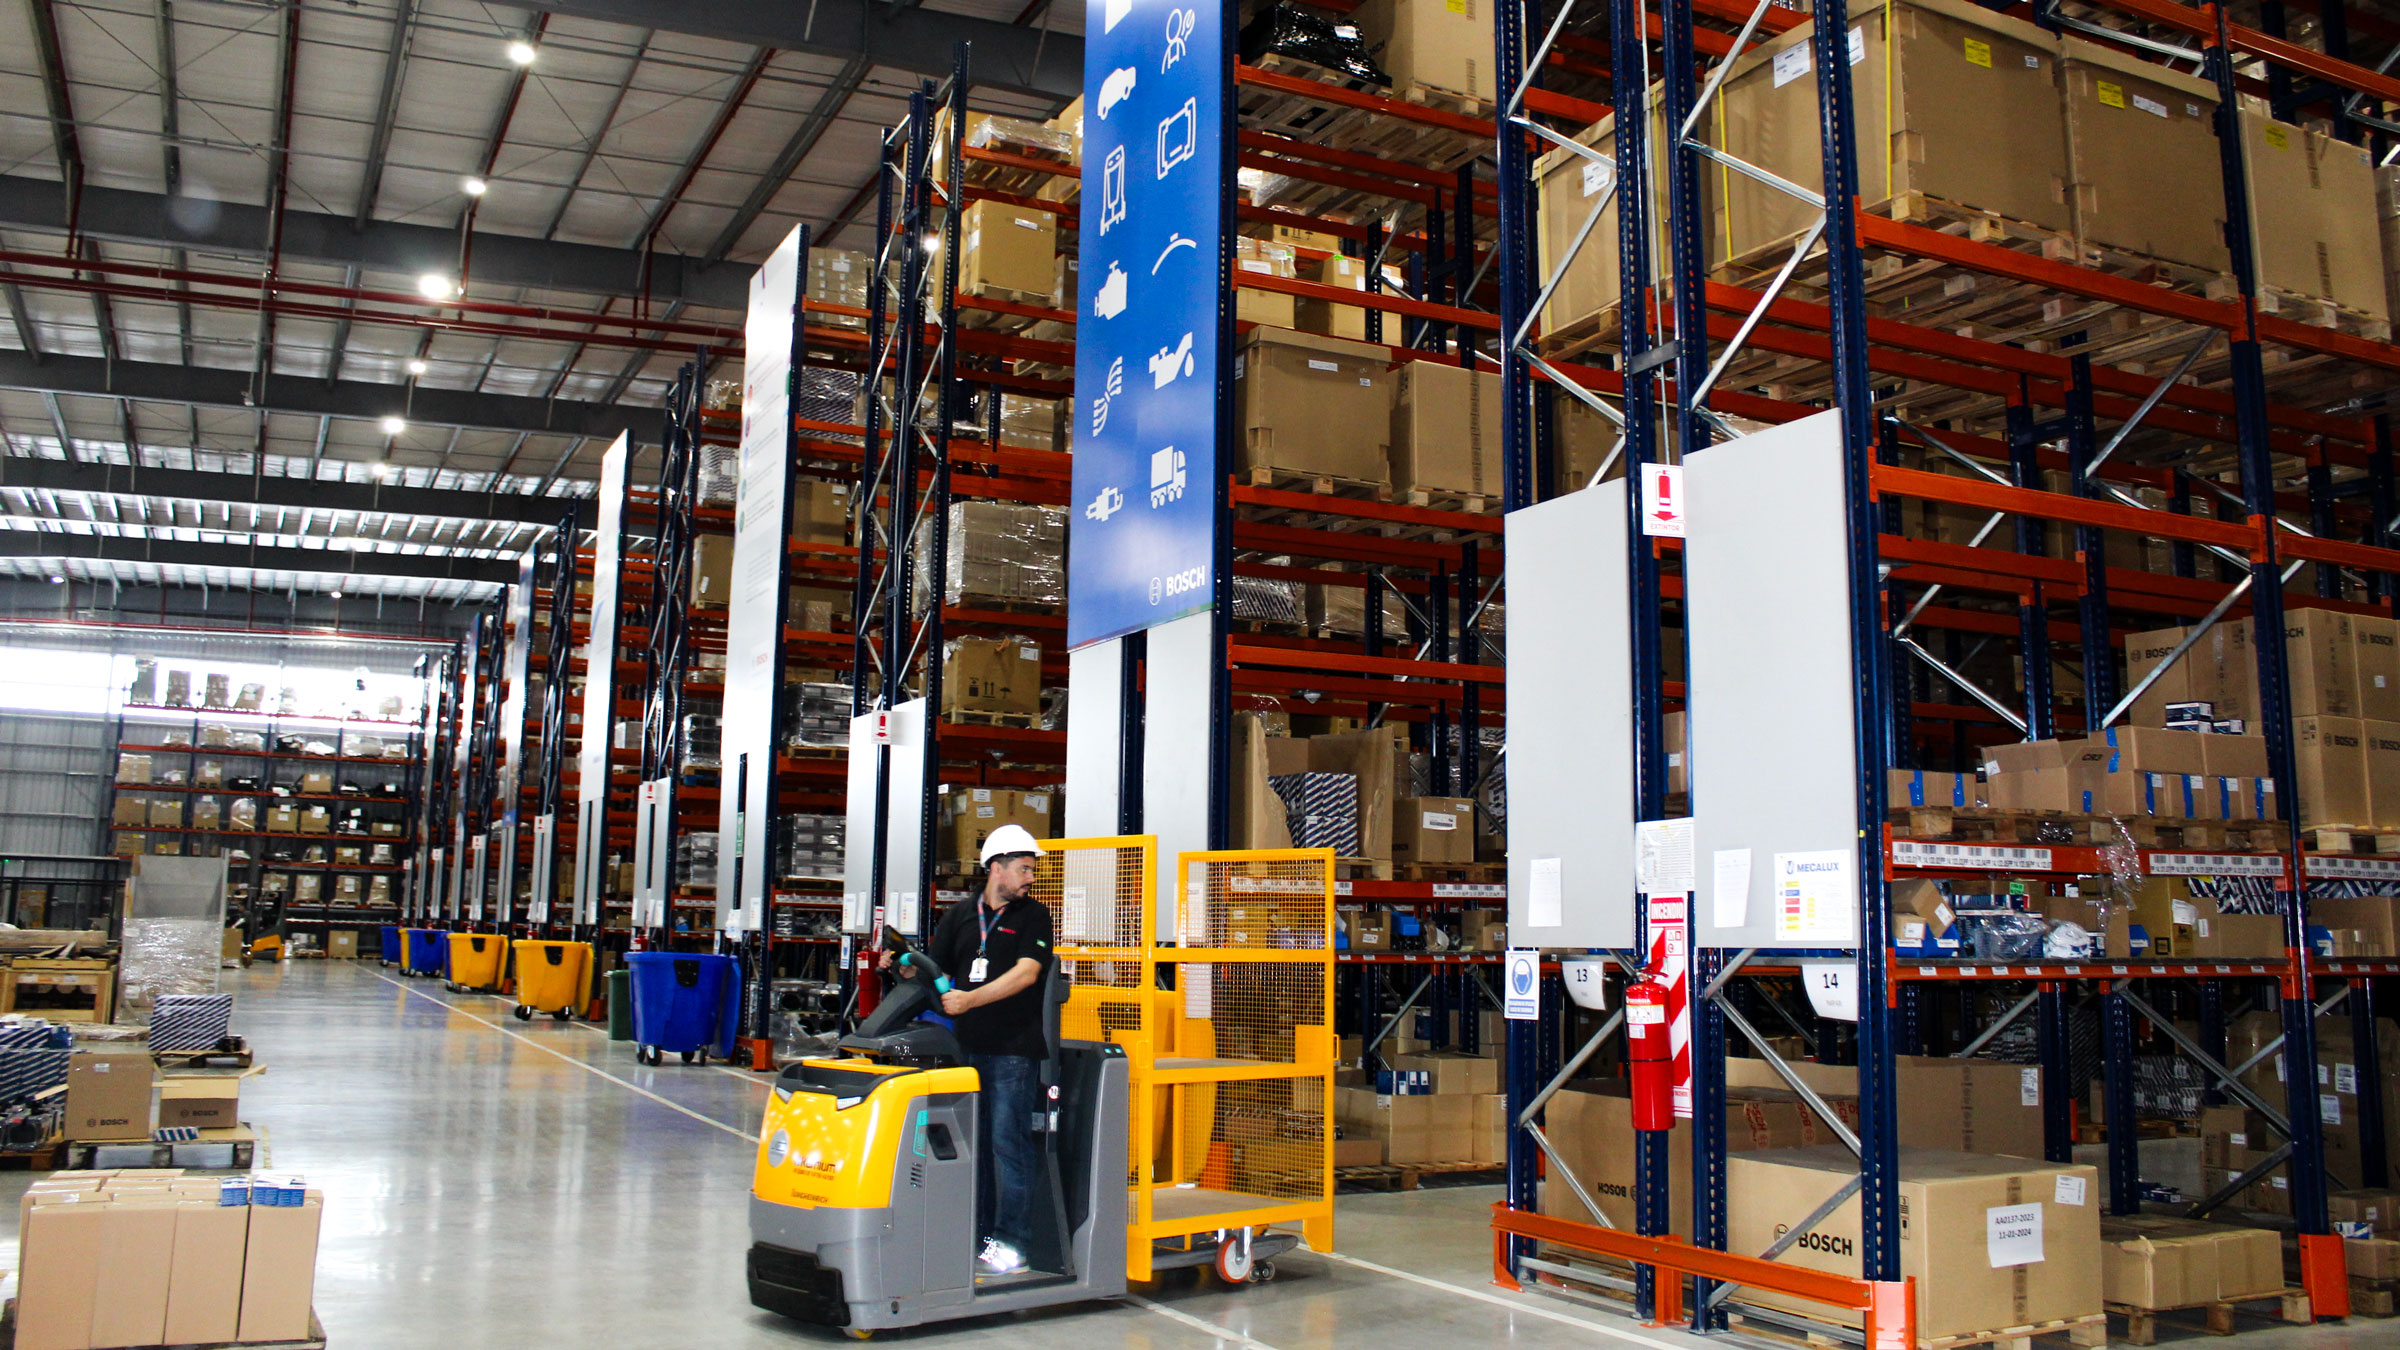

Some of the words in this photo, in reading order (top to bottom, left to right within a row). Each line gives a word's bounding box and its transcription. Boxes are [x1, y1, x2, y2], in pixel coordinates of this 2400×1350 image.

[1650, 523, 1680, 531] EXTINTOR
[1166, 565, 1205, 597] BOSCH
[2369, 633, 2394, 646] BOSCH
[2145, 646, 2176, 658] BOSC
[2334, 735, 2359, 747] BOSCH
[1797, 862, 1840, 873] MECALUX
[1651, 902, 1684, 920] INCENDIO
[1577, 968, 1588, 982] 13
[1823, 973, 1838, 988] 14
[1598, 1182, 1627, 1198] BOSCH
[1799, 1232, 1852, 1256] BOSCH
